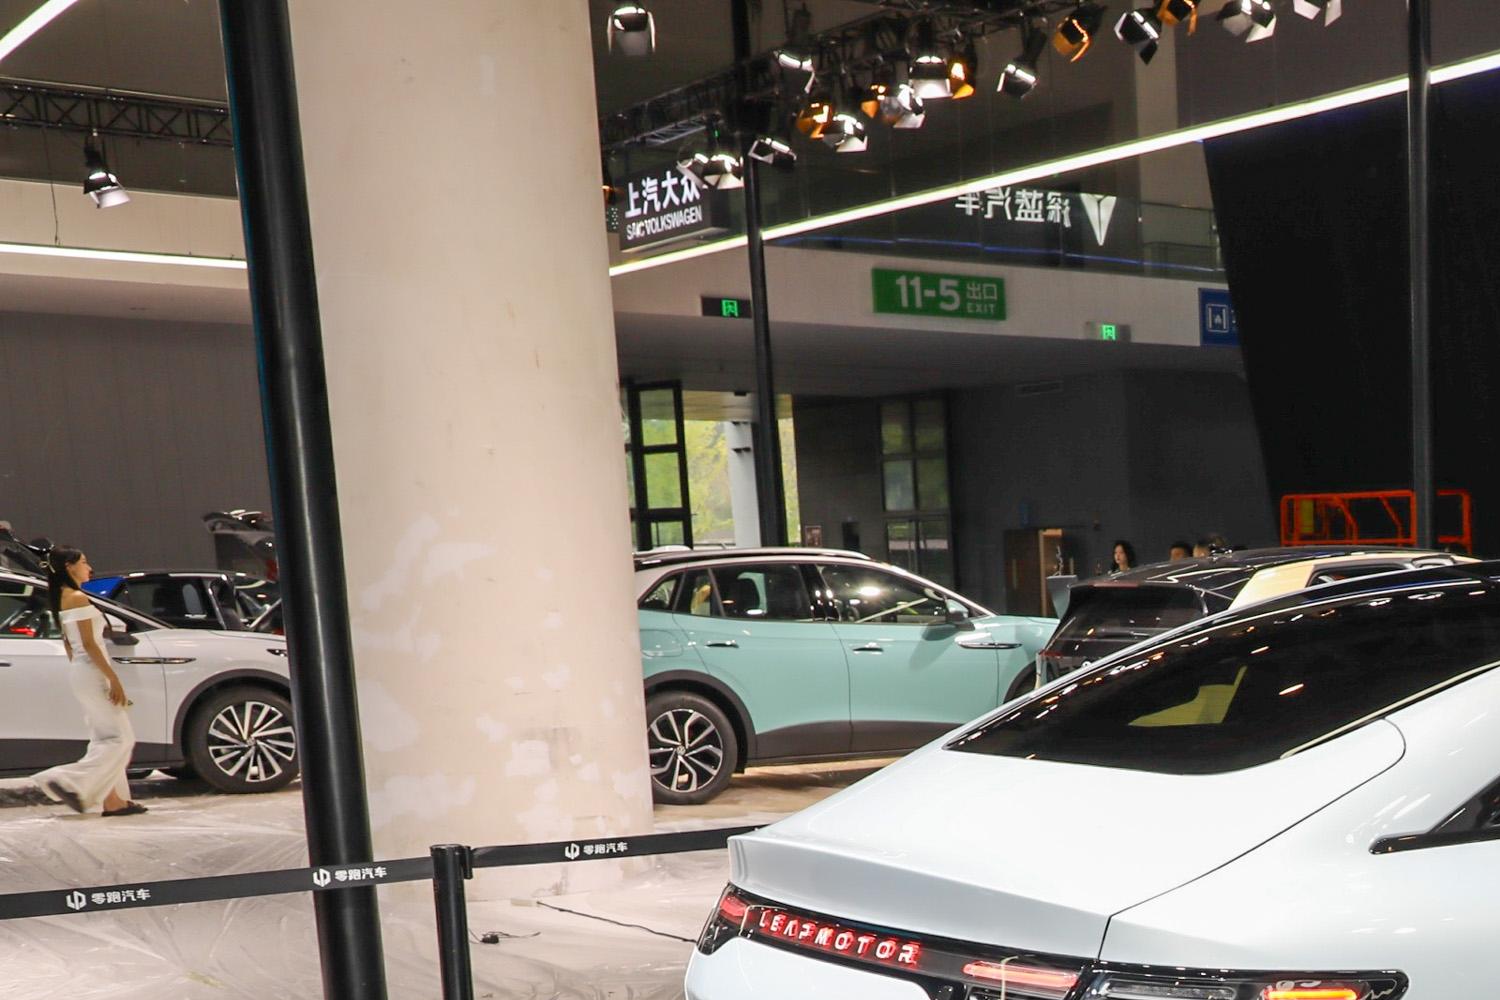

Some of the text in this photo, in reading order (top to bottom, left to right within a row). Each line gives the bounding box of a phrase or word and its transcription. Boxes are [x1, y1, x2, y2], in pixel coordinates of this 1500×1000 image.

[624, 170, 701, 218] 上汽大众
[626, 205, 703, 240] SAIC VOLKSWAGEN
[895, 274, 998, 312] 11-5 出口
[966, 302, 996, 315] EXIT
[91, 887, 151, 904] 零跑汽车
[758, 907, 921, 966] LEAPMOTOR
